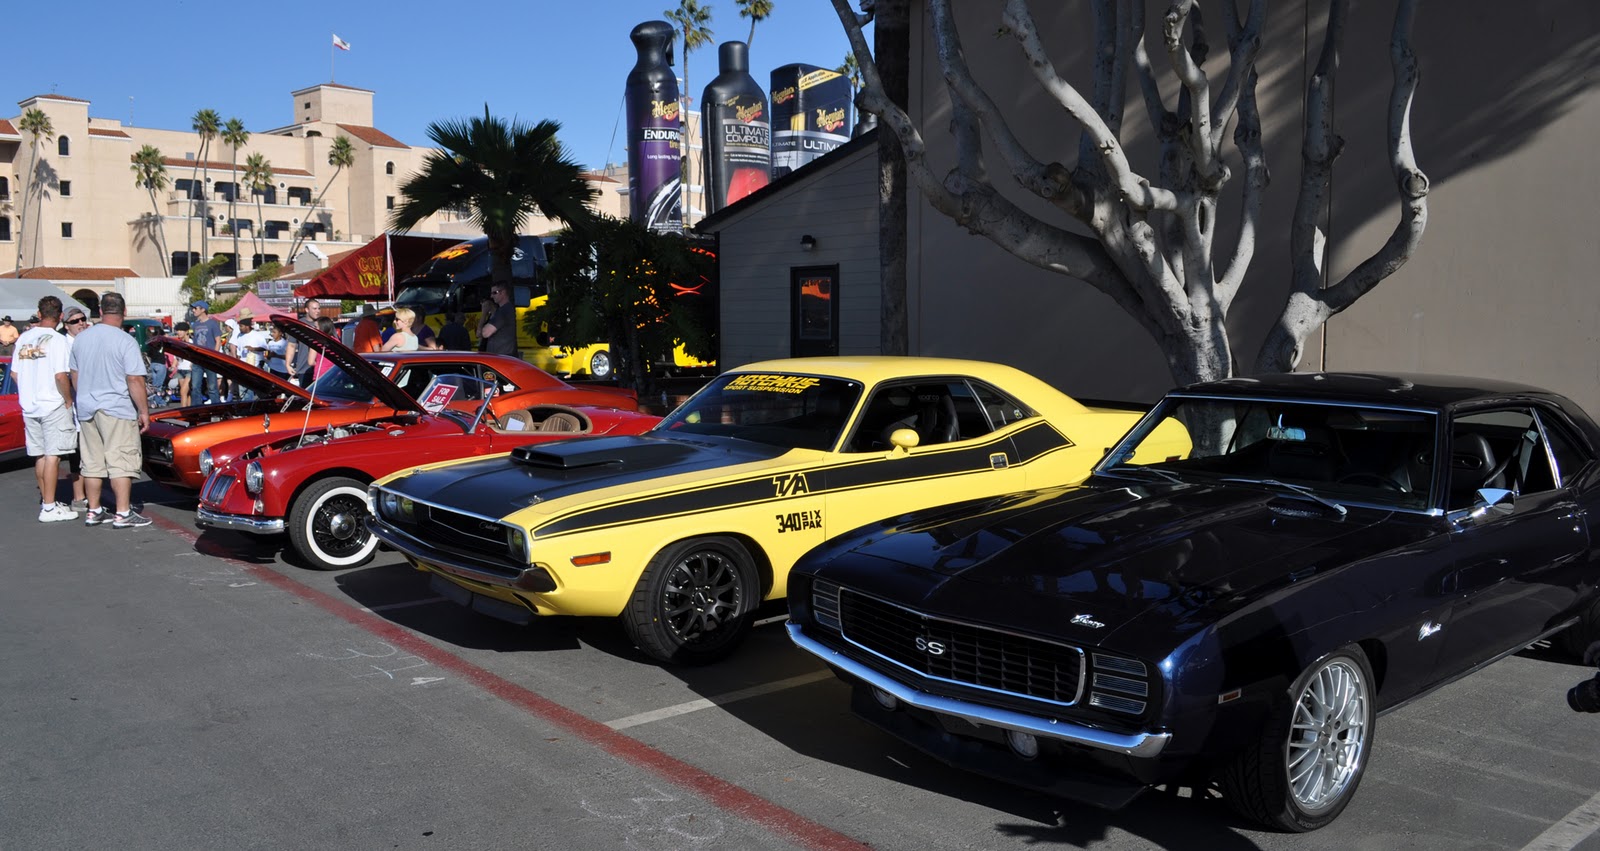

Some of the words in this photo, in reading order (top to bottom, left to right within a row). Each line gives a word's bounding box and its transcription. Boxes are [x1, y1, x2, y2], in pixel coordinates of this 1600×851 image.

[725, 125, 769, 136] ULTIMATE
[725, 134, 769, 146] COMPOUND
[728, 374, 820, 389] HOTCHKIS
[437, 387, 451, 396] FOR
[747, 385, 804, 394] SUSPENSION
[431, 395, 447, 403] SALE
[775, 512, 802, 534] 340
[801, 509, 822, 521] SIX
[802, 519, 823, 530] PAK
[915, 637, 944, 655] SS
